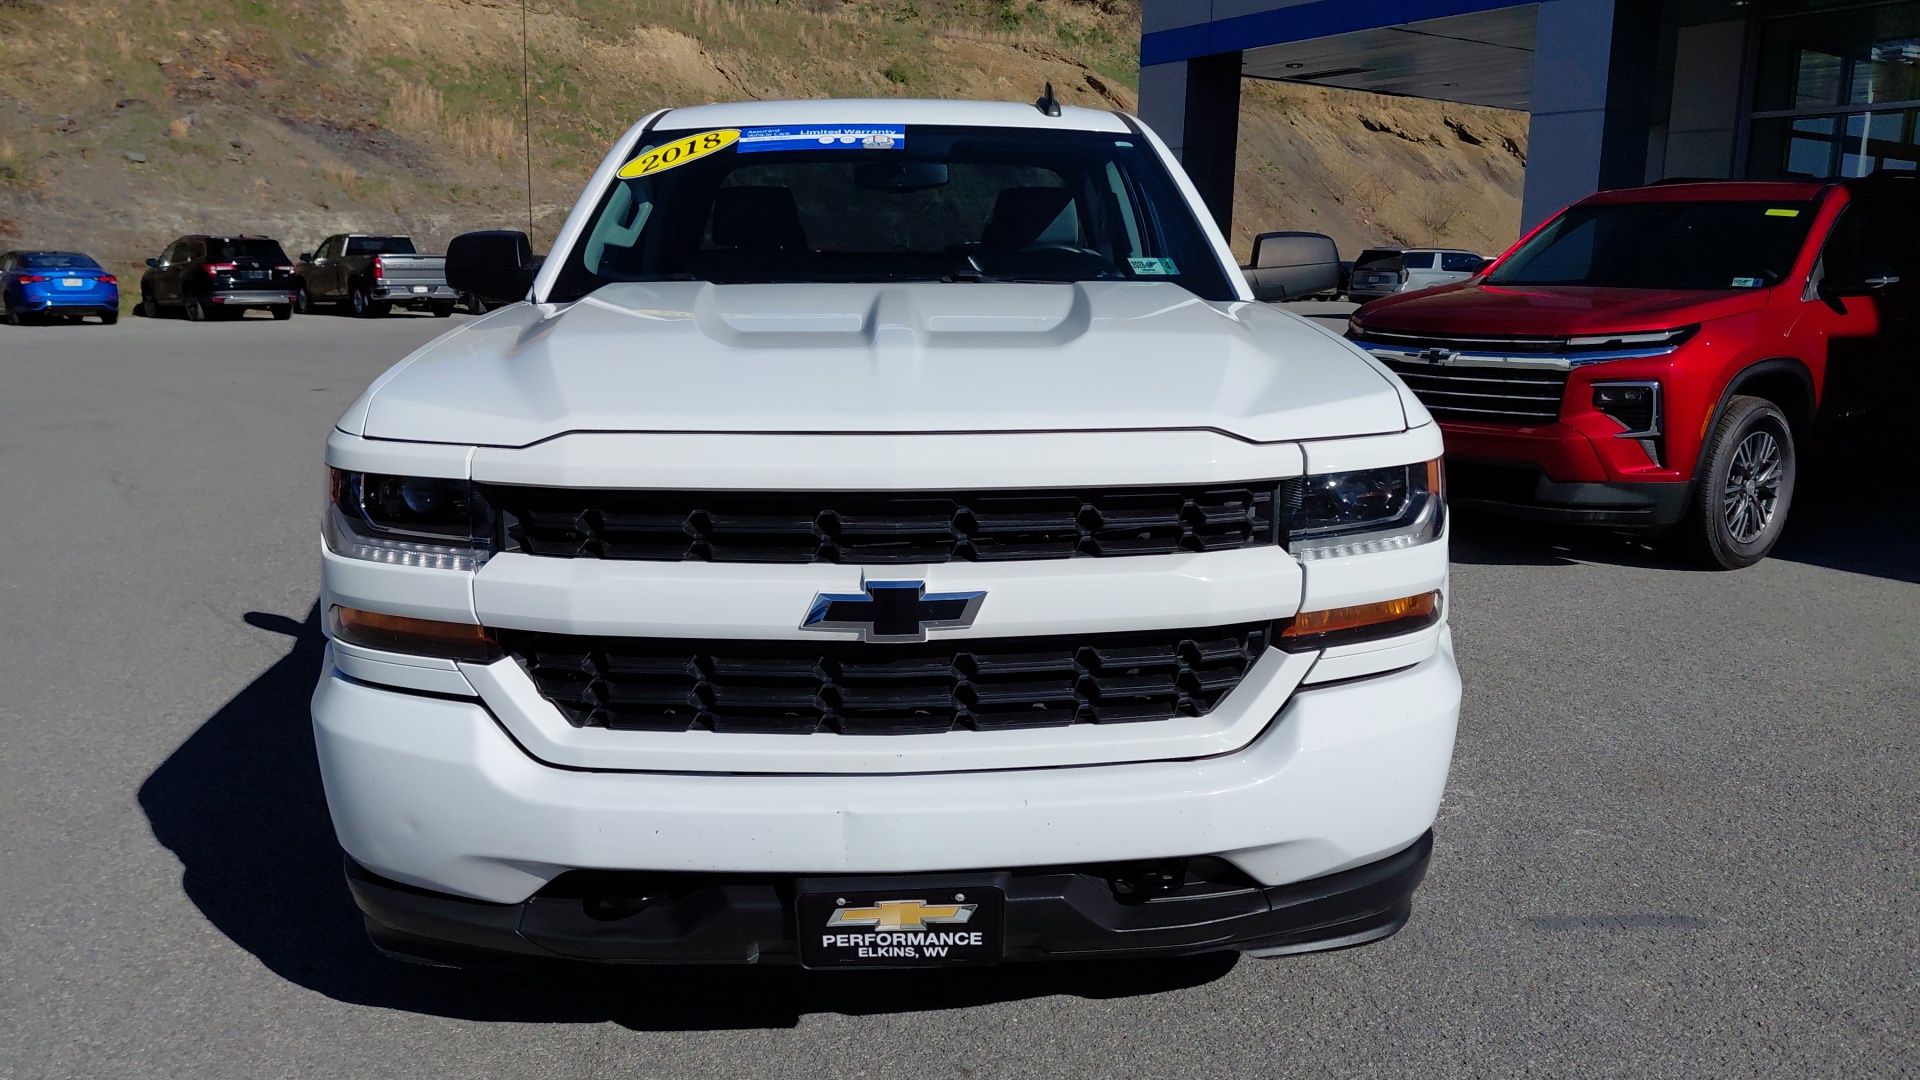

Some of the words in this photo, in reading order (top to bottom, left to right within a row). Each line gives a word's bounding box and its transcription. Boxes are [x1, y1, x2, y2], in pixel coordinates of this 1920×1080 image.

[642, 133, 721, 173] 2018
[822, 932, 983, 948] PERFORMANCE
[858, 947, 919, 959] ELKINS,
[923, 946, 949, 957] WV
